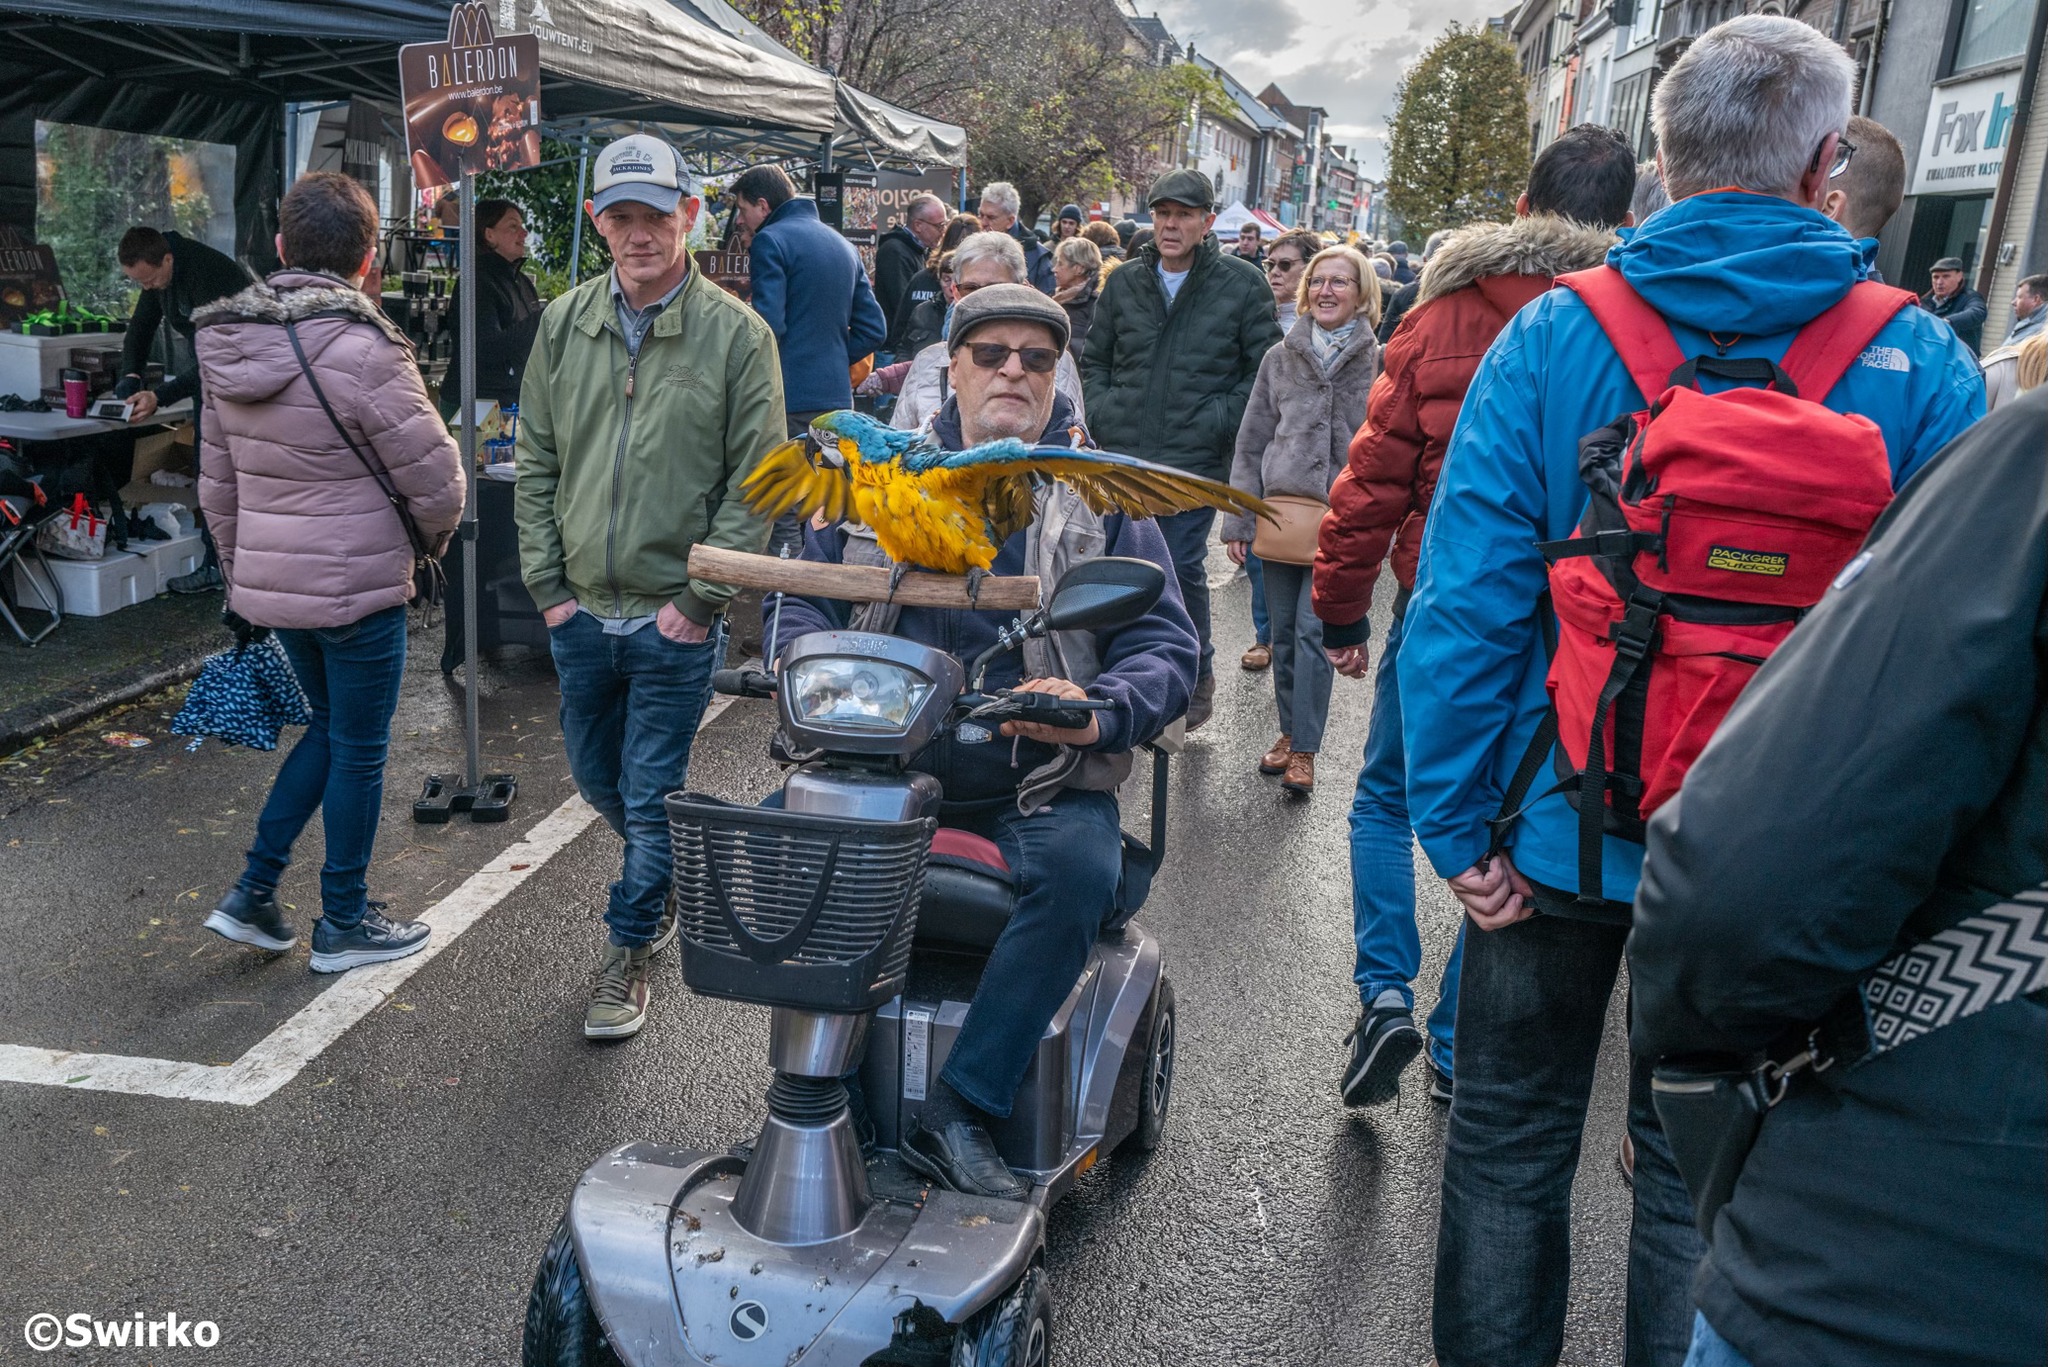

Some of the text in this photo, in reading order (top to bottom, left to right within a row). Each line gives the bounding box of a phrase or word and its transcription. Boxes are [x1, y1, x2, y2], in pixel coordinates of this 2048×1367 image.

[428, 45, 518, 89] BALERDON
[447, 84, 503, 101] www.balerdon.be
[1857, 351, 1890, 364] ORTH
[1870, 345, 1892, 355] THE
[1861, 360, 1890, 370] FACE
[1712, 548, 1786, 564] PACKGREK
[1711, 558, 1783, 573] Outdoor
